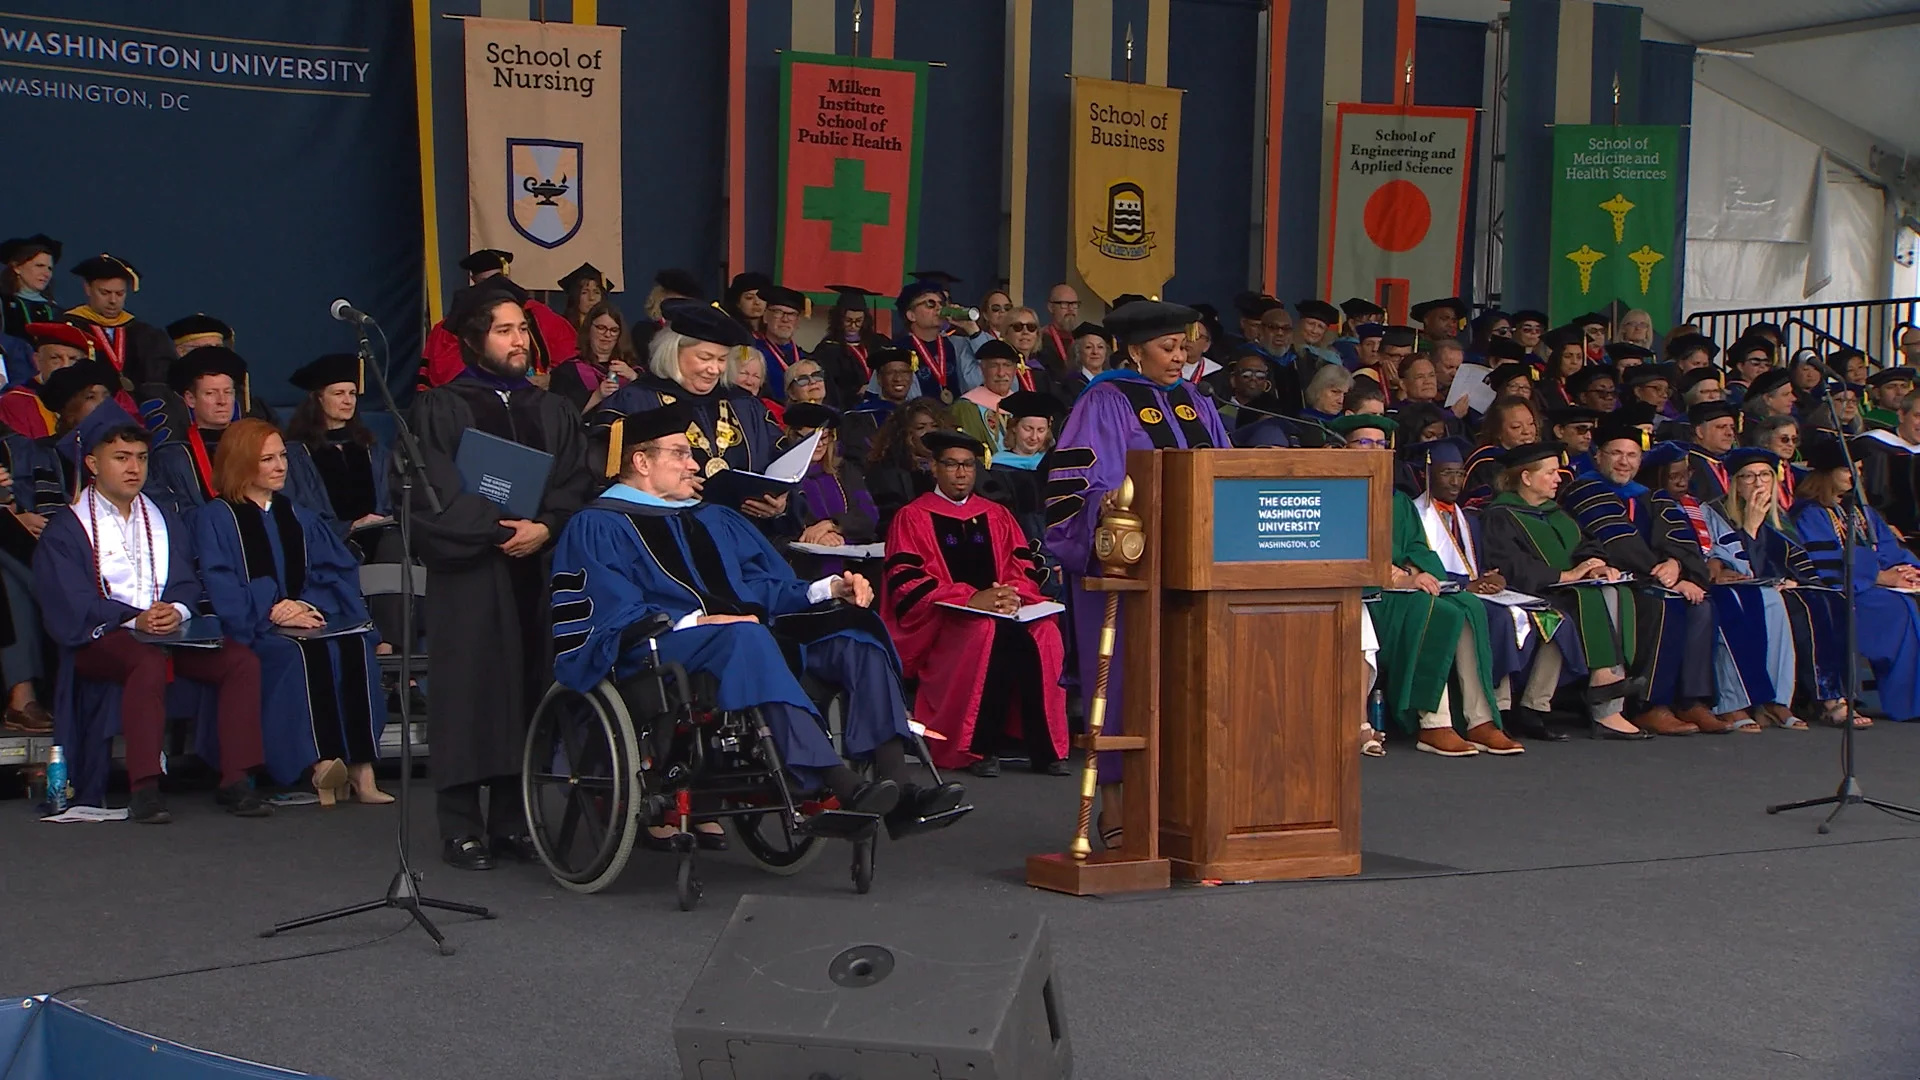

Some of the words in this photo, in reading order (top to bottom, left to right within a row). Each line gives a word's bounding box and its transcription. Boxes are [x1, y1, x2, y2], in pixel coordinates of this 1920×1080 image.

[0, 28, 200, 71] WASHINGTON
[210, 52, 370, 83] UNIVERSITY
[486, 43, 570, 68] School
[577, 50, 602, 69] of
[493, 67, 595, 98] Nursing
[828, 78, 881, 97] Milken
[0, 78, 153, 110] WASHINGTON,
[161, 93, 190, 111] DC
[818, 95, 885, 115] Institute
[816, 112, 867, 130] School
[870, 118, 888, 132] of
[1090, 102, 1145, 127] School
[1150, 112, 1168, 130] of
[798, 128, 848, 146] Public
[851, 132, 902, 151] Health
[1091, 125, 1165, 152] Business
[1375, 129, 1417, 142] School
[1420, 131, 1436, 143] of
[1588, 137, 1632, 150] School
[1635, 137, 1649, 150] of
[1350, 143, 1428, 162] Engineering
[1431, 148, 1456, 159] and
[1573, 152, 1632, 165] Medicine
[1634, 152, 1660, 165] and
[1350, 160, 1402, 175] Applied
[1405, 161, 1453, 175] Science
[1565, 167, 1609, 180] Health
[1612, 166, 1667, 180] Sciences
[1259, 496, 1278, 506] THE
[1280, 496, 1321, 506] GEORGE
[1258, 509, 1321, 519] WASHINGTON
[1258, 521, 1321, 532] UNIVERSITY
[1258, 540, 1309, 549] WASHINGTON,
[1310, 540, 1321, 548] DC
